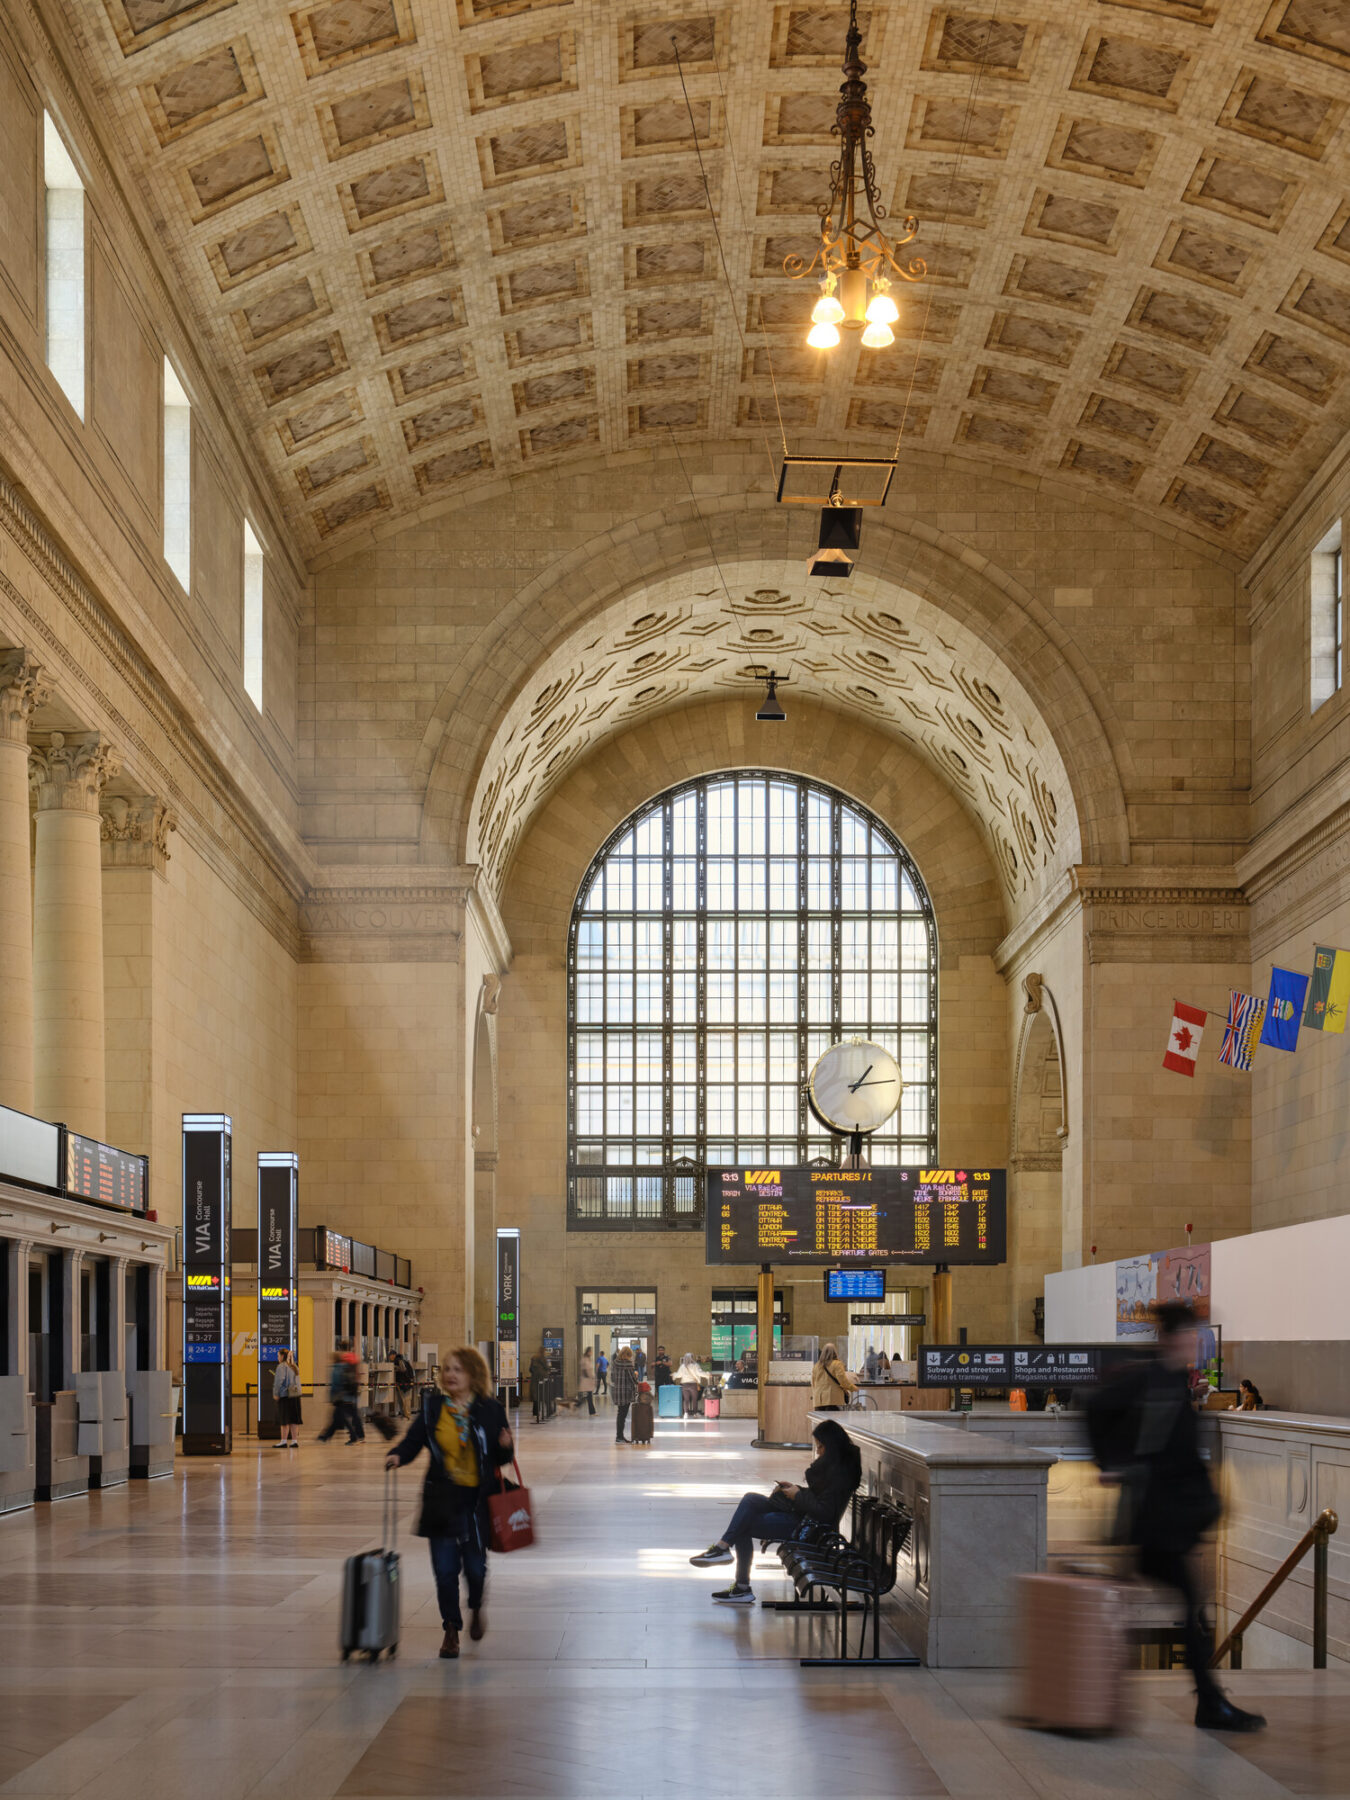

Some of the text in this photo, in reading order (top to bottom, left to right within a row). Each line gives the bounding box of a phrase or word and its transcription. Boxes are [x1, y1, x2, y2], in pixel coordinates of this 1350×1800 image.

[304, 909, 450, 929] VANCOUVER
[1098, 910, 1245, 929] PRINCE RUPERT
[721, 1173, 739, 1182] 13:13
[744, 1170, 780, 1184] VIA
[920, 1170, 956, 1184] VIA
[973, 1172, 991, 1181] 13:13
[195, 1223, 210, 1254] VIA
[269, 1244, 282, 1270] VIA
[188, 1275, 212, 1286] VIA
[262, 1288, 282, 1296] VIA
[504, 1274, 512, 1302] YORK
[958, 1374, 989, 1382] tramway
[1015, 1374, 1048, 1382] Magasins
